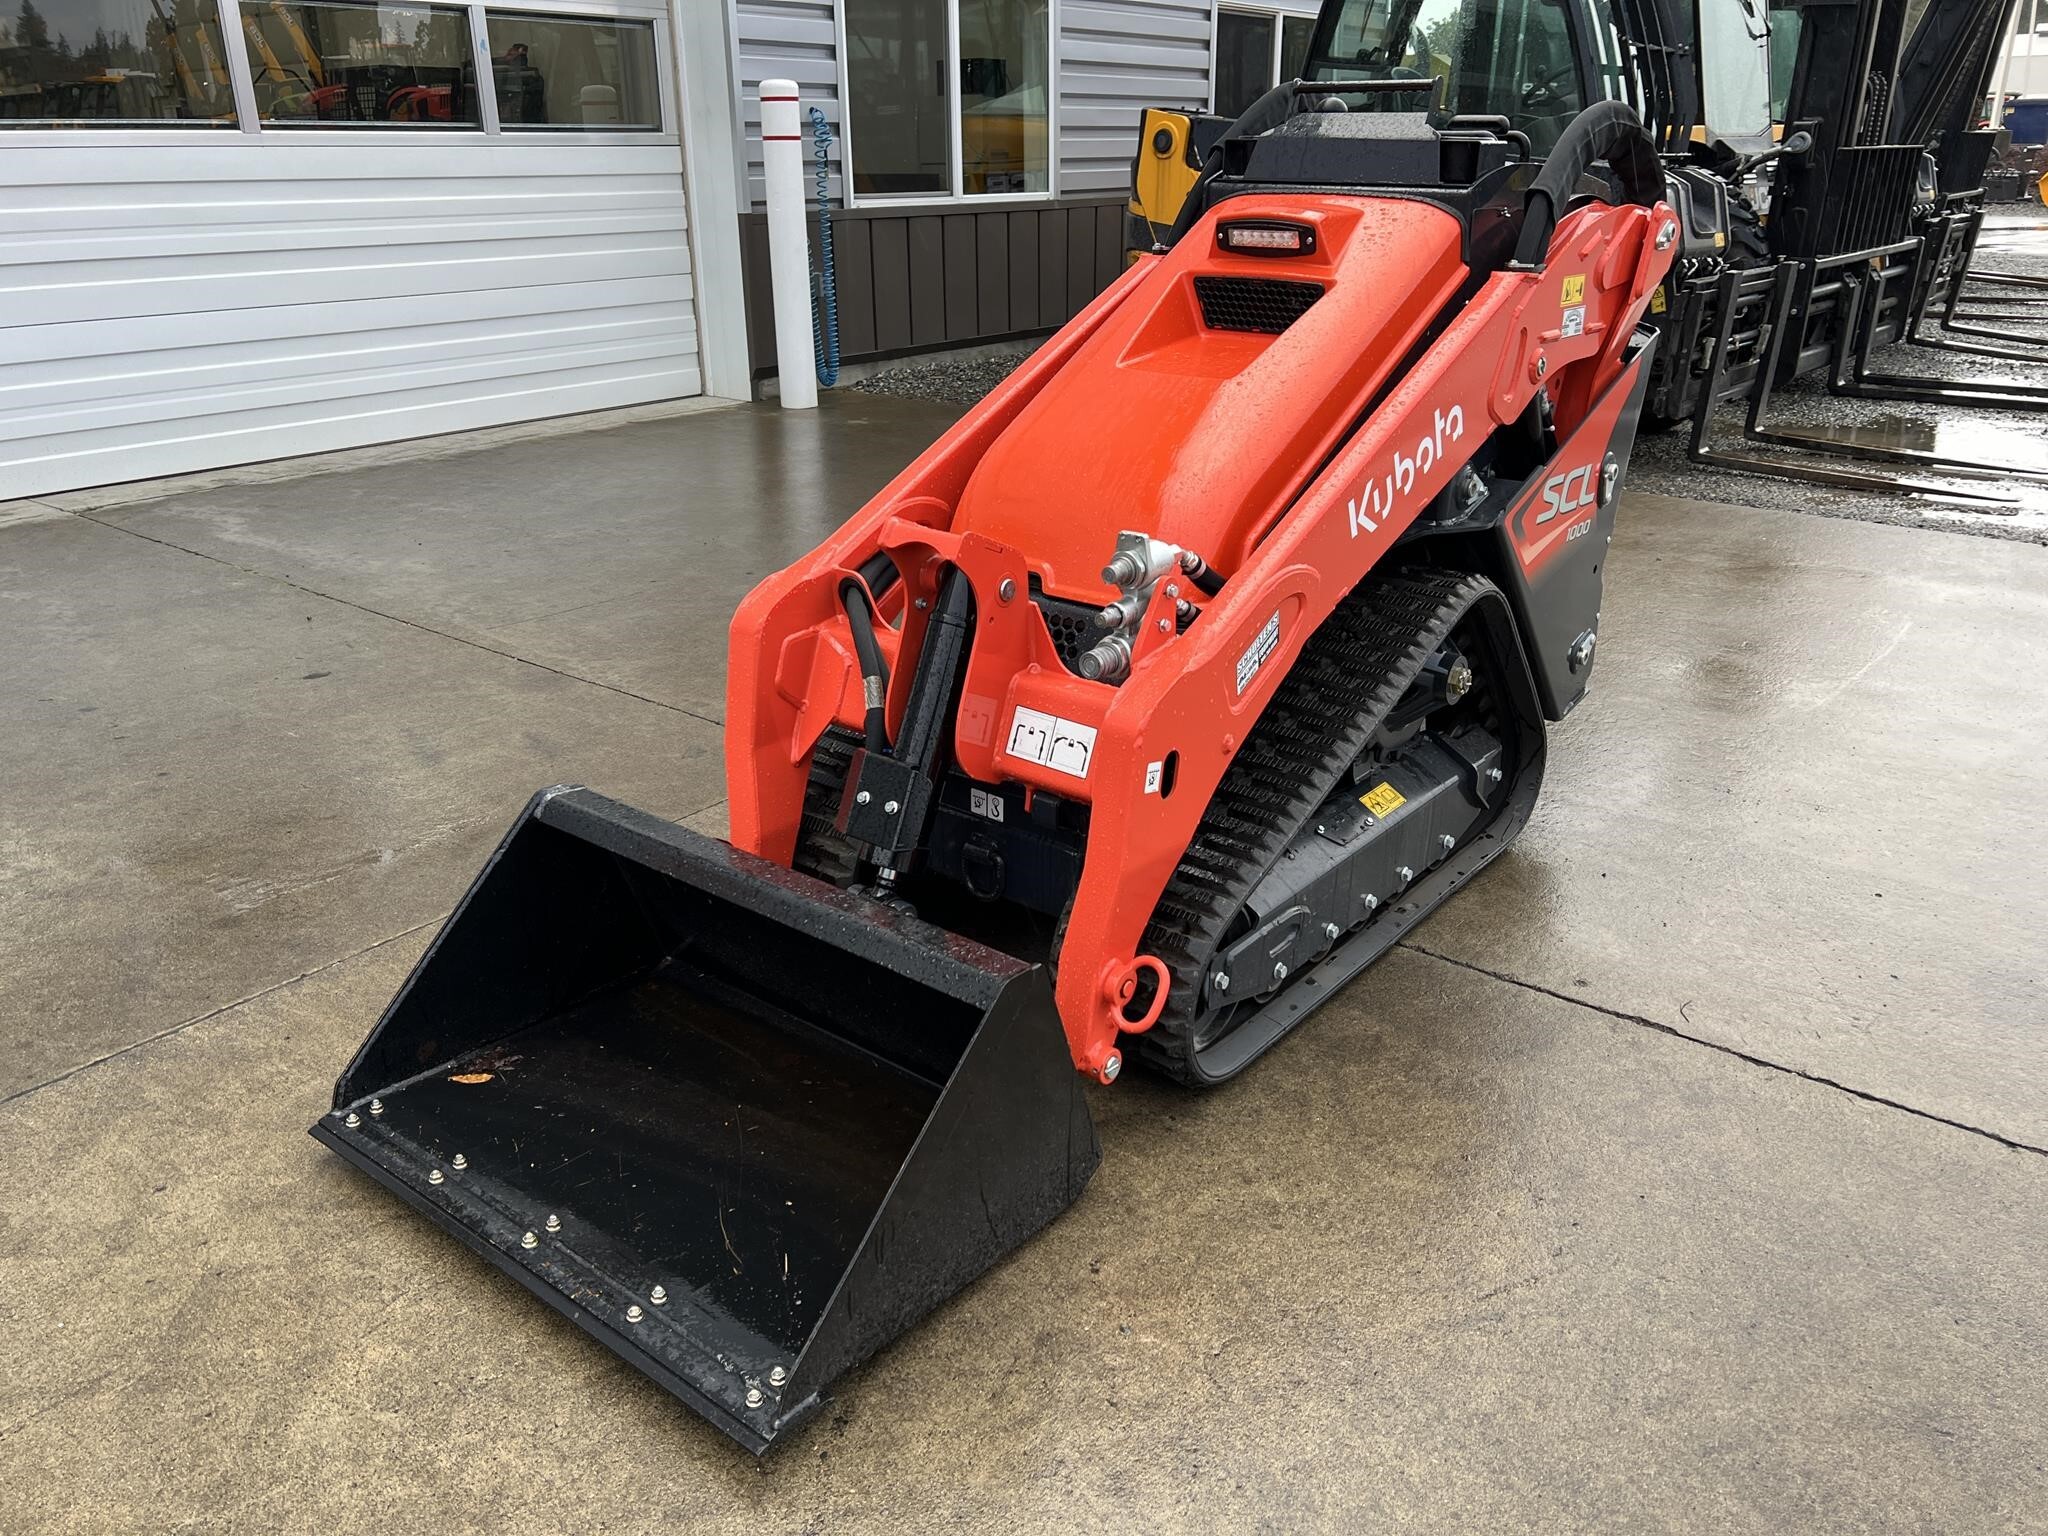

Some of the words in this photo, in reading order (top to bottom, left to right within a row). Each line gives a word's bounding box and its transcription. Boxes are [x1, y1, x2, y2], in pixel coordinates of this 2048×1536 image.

[1348, 405, 1463, 539] Kubota
[1536, 463, 1595, 525] SCL
[1566, 519, 1591, 542] 1000
